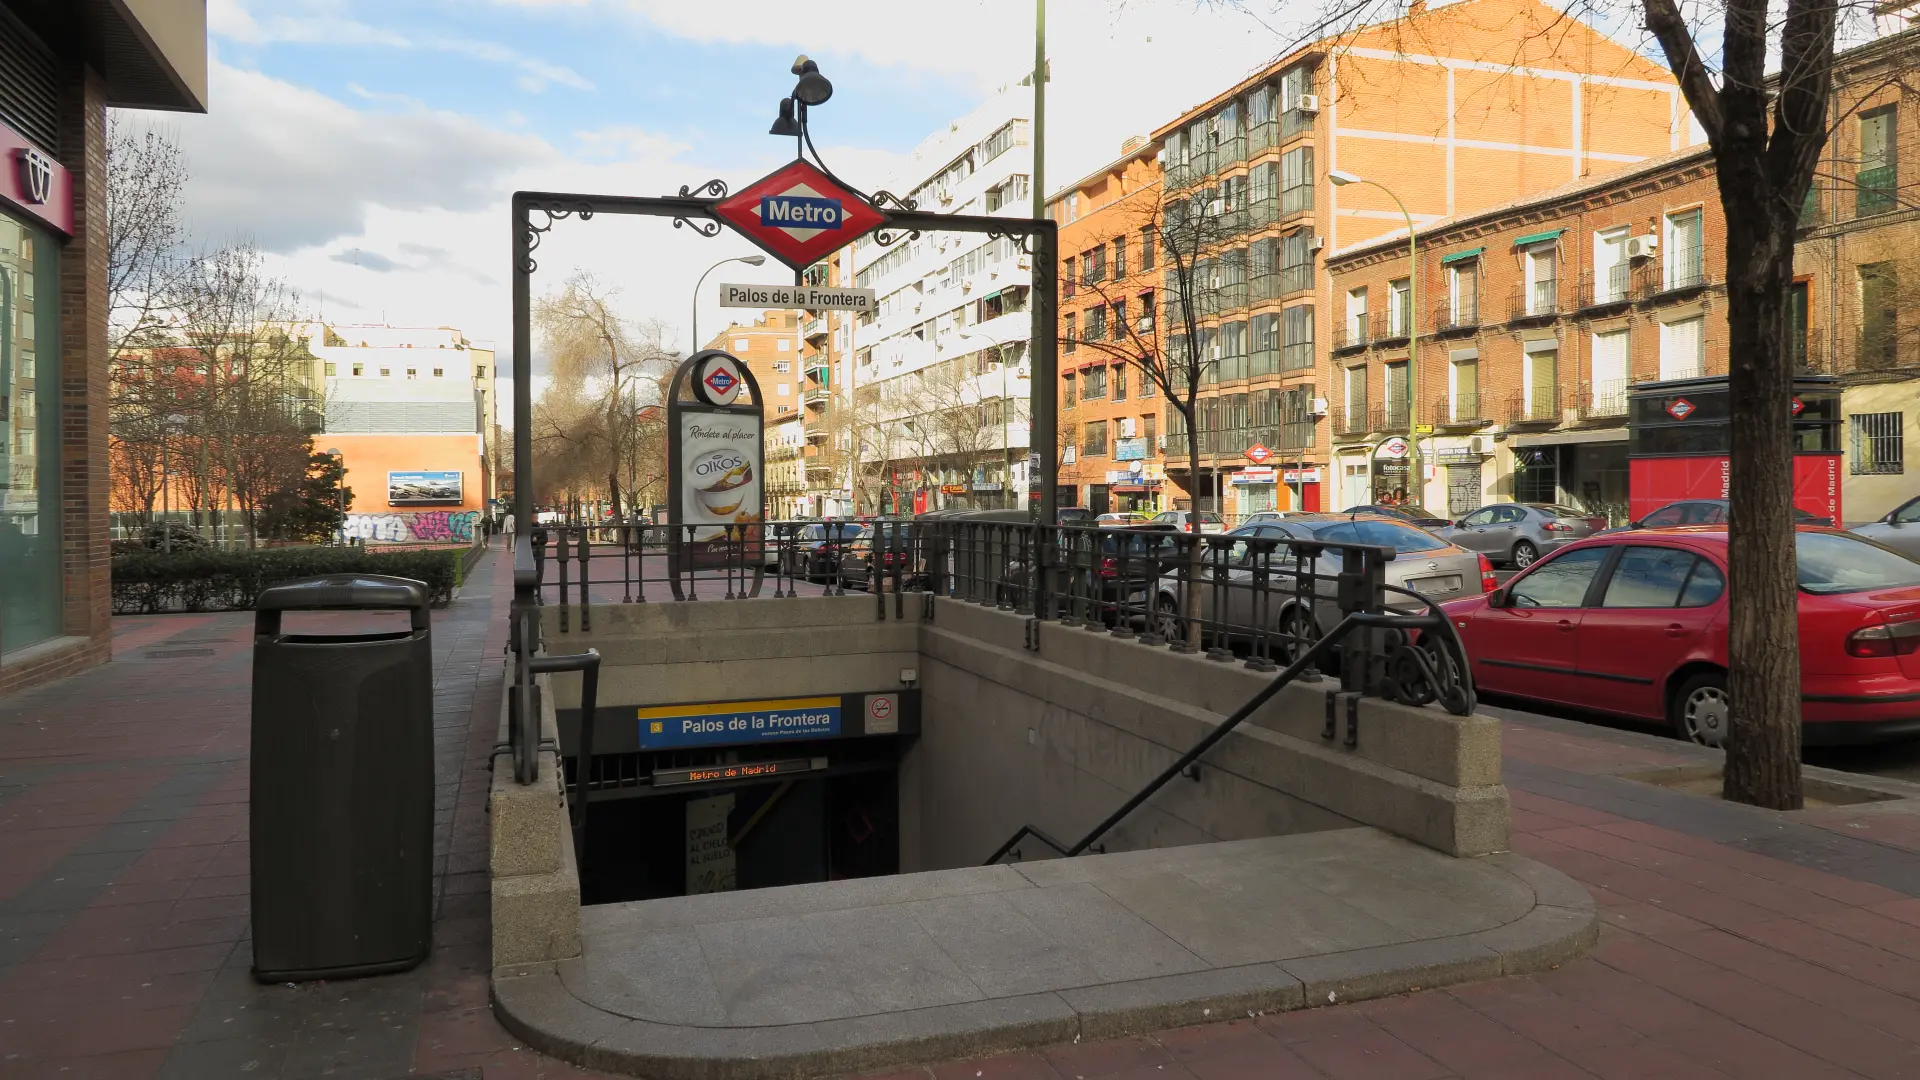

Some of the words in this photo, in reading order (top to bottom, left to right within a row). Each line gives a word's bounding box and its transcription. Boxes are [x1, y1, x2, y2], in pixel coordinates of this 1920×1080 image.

[769, 200, 836, 223] Metro
[729, 287, 768, 303] Palos
[772, 289, 789, 304] de
[793, 289, 805, 304] la
[810, 290, 866, 307] Frontera
[712, 377, 730, 385] Metro
[722, 428, 731, 439] al
[731, 429, 755, 441] placer
[1720, 461, 1730, 498] Madrid
[1828, 459, 1836, 496] Madrid
[1828, 498, 1836, 512] de
[654, 723, 660, 732] 3
[682, 719, 724, 734] Palos
[728, 717, 747, 731] de
[752, 716, 764, 729] la
[769, 713, 830, 728] Frontera
[690, 771, 720, 780] Metro
[724, 768, 737, 777] de
[741, 764, 776, 775] Madrid
